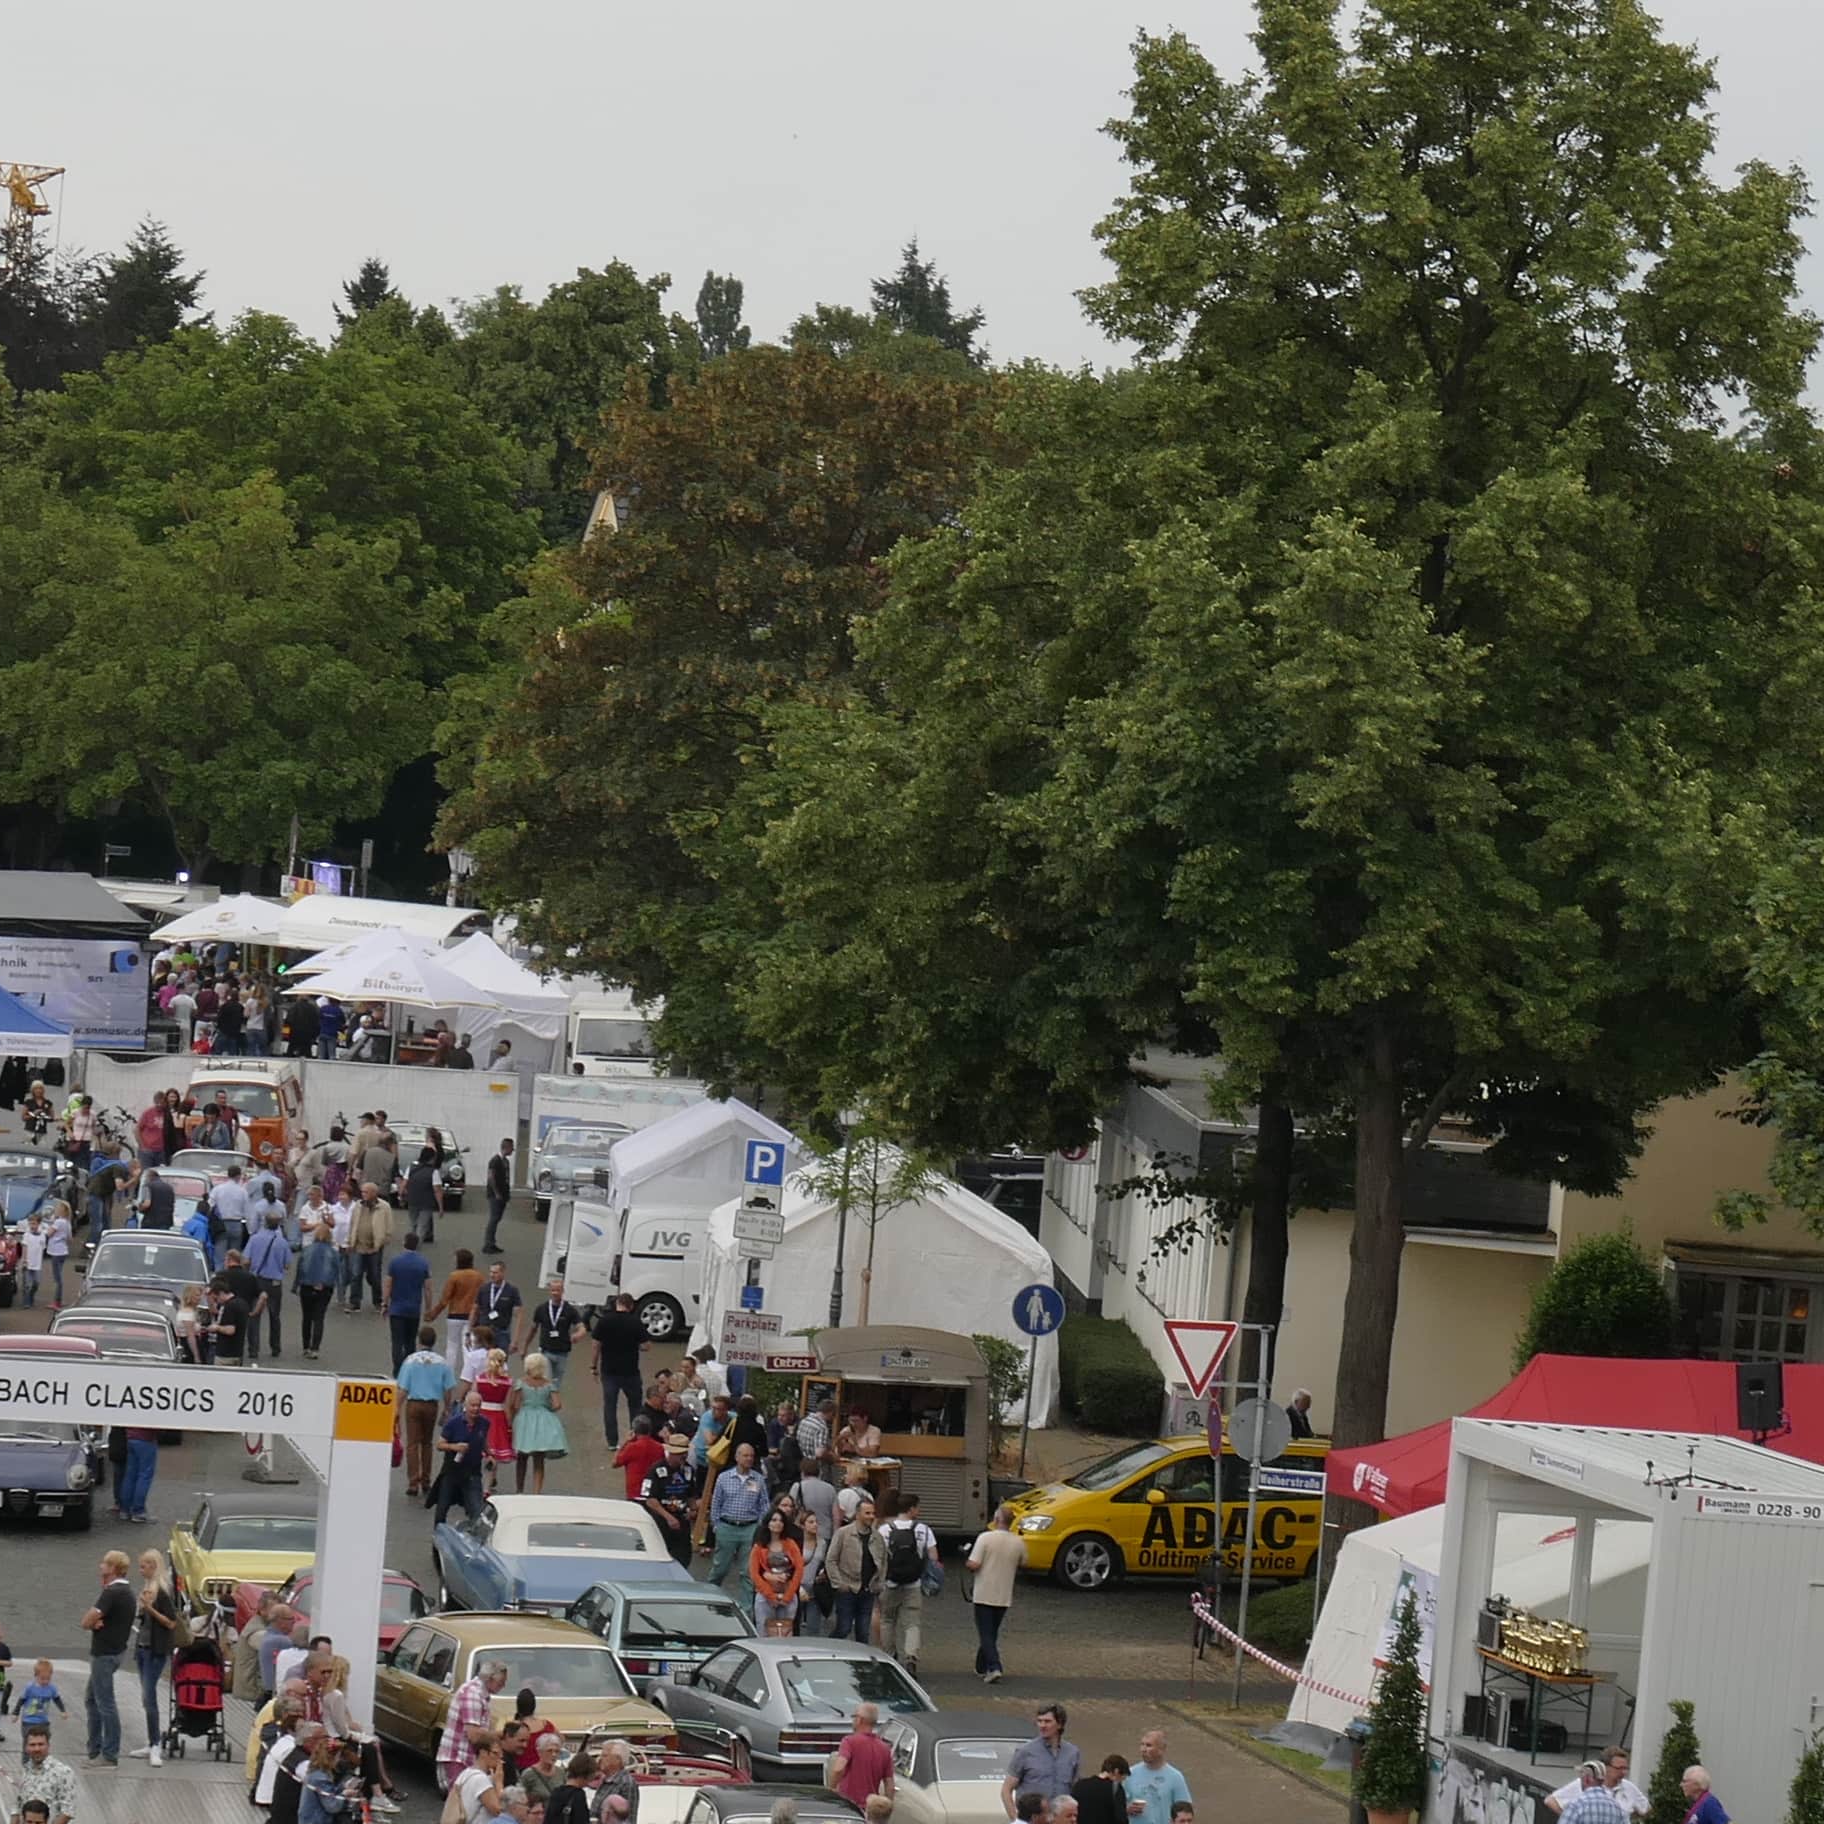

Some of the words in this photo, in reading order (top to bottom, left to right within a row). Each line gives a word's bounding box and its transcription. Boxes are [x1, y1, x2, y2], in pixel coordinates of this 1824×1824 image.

[751, 1145, 777, 1179] P
[648, 1231, 692, 1250] JVG
[726, 1314, 778, 1332] Parkplatz
[85, 1383, 215, 1412] CLASSICS
[237, 1390, 294, 1417] 2016
[339, 1385, 394, 1406] ADAC
[1756, 1503, 1792, 1517] 0228
[1803, 1506, 1821, 1519] 90
